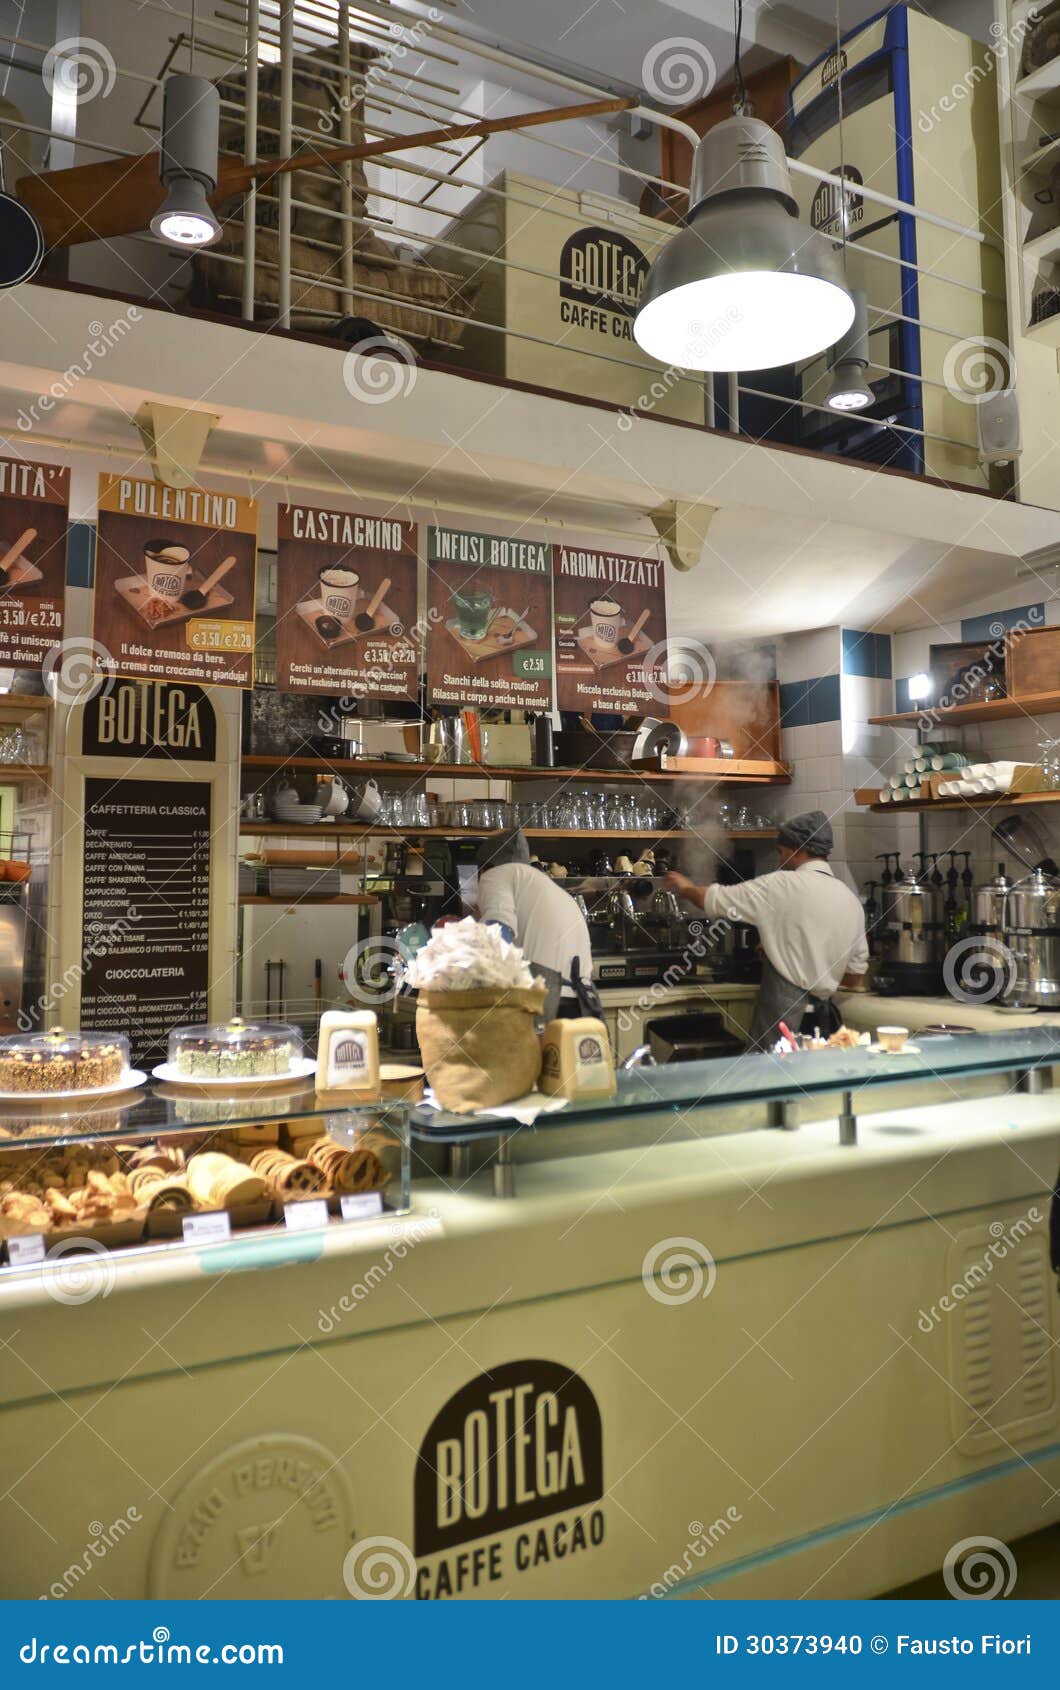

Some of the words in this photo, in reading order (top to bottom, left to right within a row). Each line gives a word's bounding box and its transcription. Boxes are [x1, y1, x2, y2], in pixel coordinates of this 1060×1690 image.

[560, 301, 608, 334] CAFFE
[612, 316, 636, 343] CA
[119, 480, 237, 529] PULENTINO
[293, 508, 402, 551] CASTAGNINO
[434, 528, 485, 564] INFUSI
[490, 540, 546, 572] BOTEGA
[560, 549, 659, 588] AROMATIZZATI
[11, 633, 19, 644] si
[13, 649, 43, 664] divina!
[130, 644, 153, 657] dolce
[155, 648, 191, 660] cremoso
[193, 650, 204, 661] da
[205, 653, 226, 665] bere.
[96, 656, 119, 669] Calda
[121, 661, 147, 671] crema
[149, 663, 164, 673] con
[165, 665, 205, 678] croccante
[206, 669, 212, 678] e
[212, 669, 248, 683] gianduja!
[290, 662, 312, 674] Cerchi
[289, 675, 307, 686] Prova
[341, 679, 347, 689] di
[443, 674, 471, 687] Stanchi
[472, 676, 490, 688] della
[491, 678, 510, 689] solita
[511, 680, 539, 692] routine?
[433, 687, 459, 701] Rilassa
[460, 690, 466, 701] il
[467, 692, 487, 705] corpo
[495, 694, 516, 705] anche
[517, 695, 524, 706] la
[525, 697, 549, 708] mente!
[577, 683, 601, 695] Miscela
[602, 686, 631, 698] esclusiva
[592, 701, 597, 709] a
[598, 699, 614, 710] base
[614, 700, 621, 710] di
[98, 680, 201, 748] BOTEGA
[91, 804, 157, 815] CAFFETTERIA
[159, 806, 207, 816] CLASSICA
[85, 841, 133, 849] DECAFFEINATO
[108, 852, 146, 860] AMERICANO
[108, 864, 122, 872] CON
[108, 876, 146, 884] SHAKERATO
[84, 888, 127, 896] CAPPUCCINO
[105, 967, 185, 980] CIOCCOLATERIA
[97, 995, 137, 1003] CIOCCOLATA
[97, 1007, 137, 1015] CIOCCOLATA
[436, 1382, 585, 1530] BOTEGA
[415, 1541, 502, 1600] CAFFE
[515, 1509, 605, 1572] CACAO
